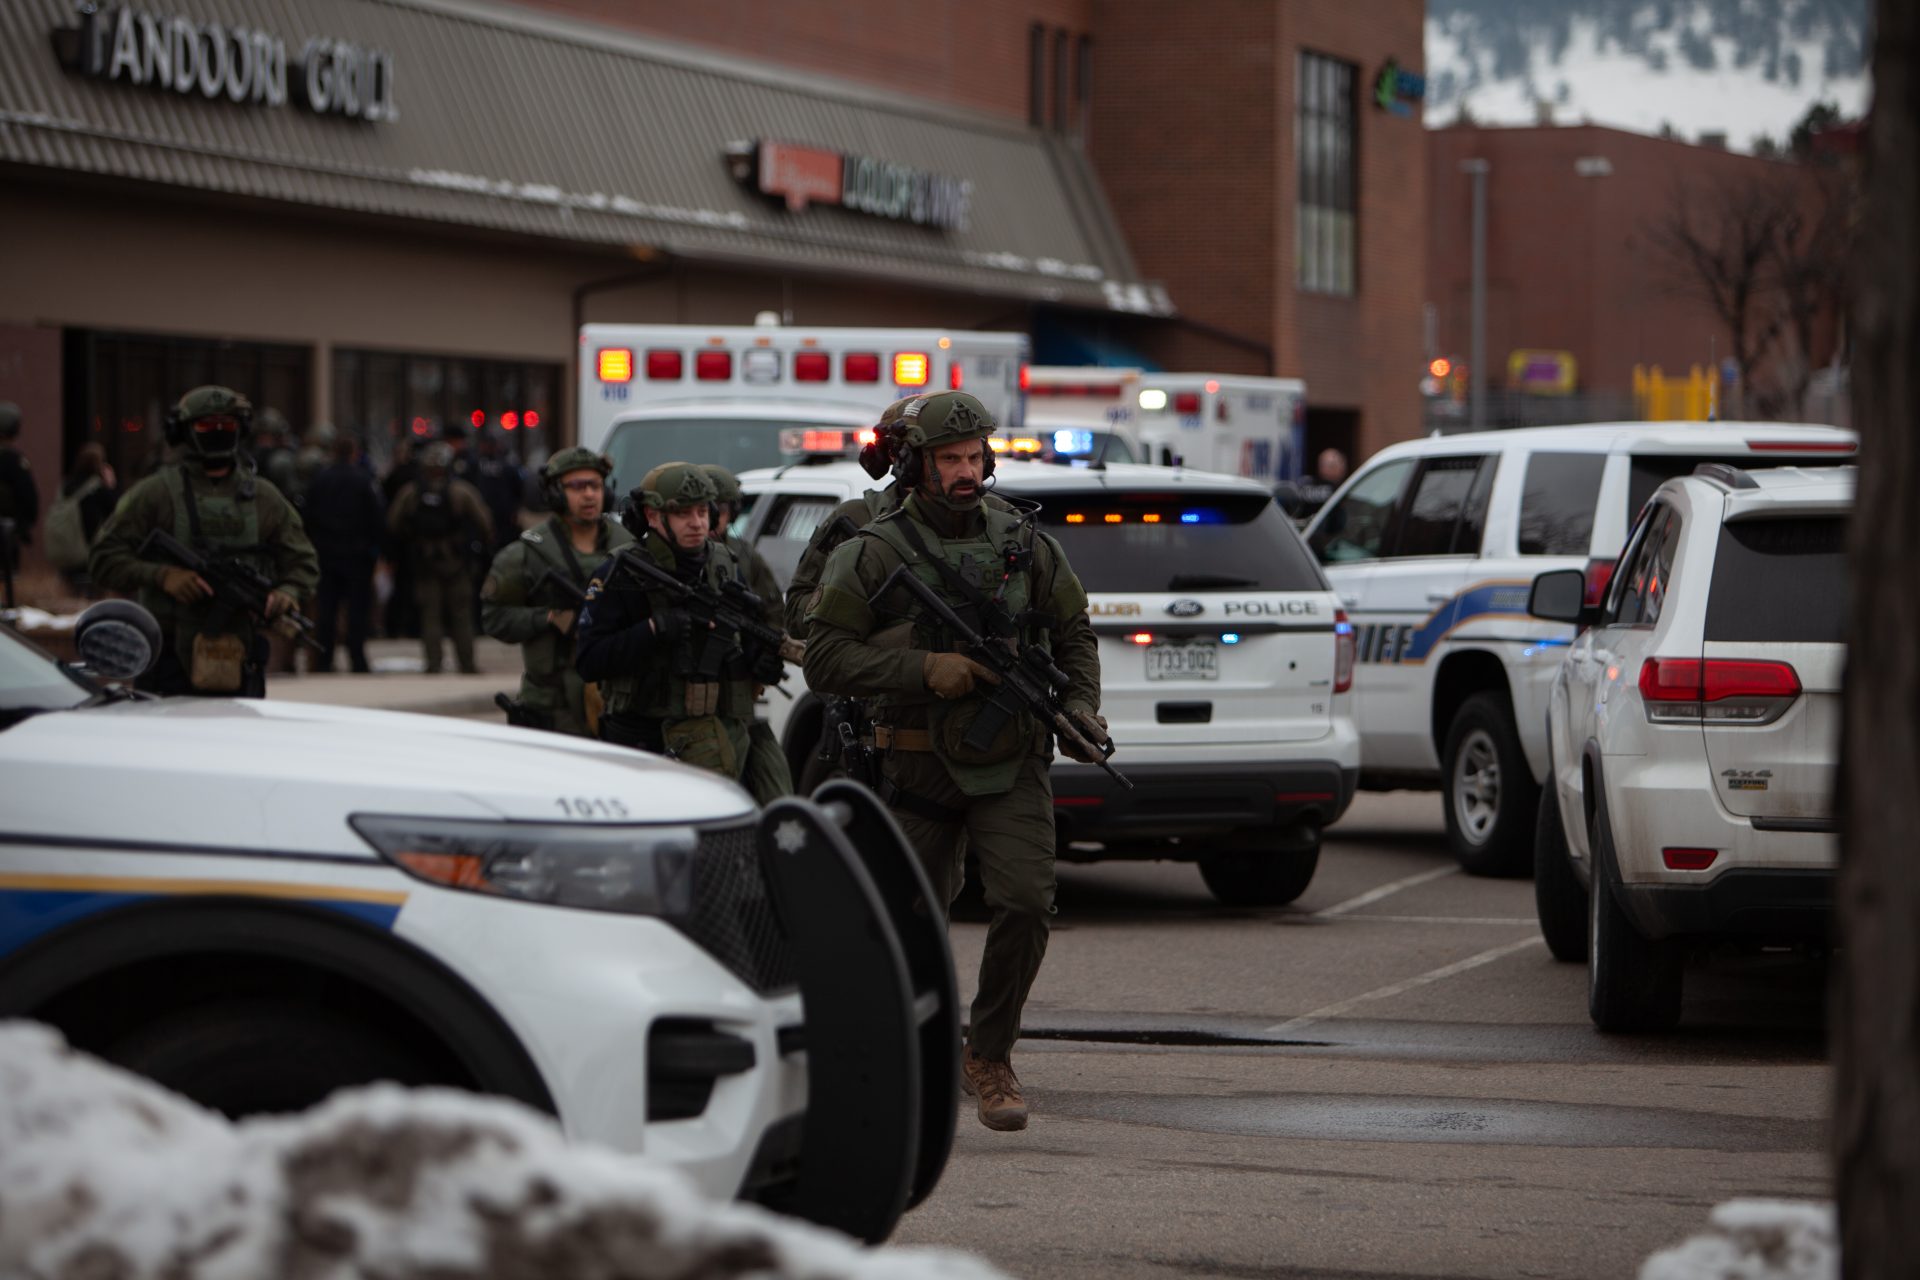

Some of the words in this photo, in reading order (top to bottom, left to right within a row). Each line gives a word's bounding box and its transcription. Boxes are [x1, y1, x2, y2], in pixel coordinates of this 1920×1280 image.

[303, 36, 400, 122] GRILL
[1089, 603, 1142, 617] ULDER
[1223, 601, 1319, 617] POLICE
[554, 797, 629, 819] 1015
